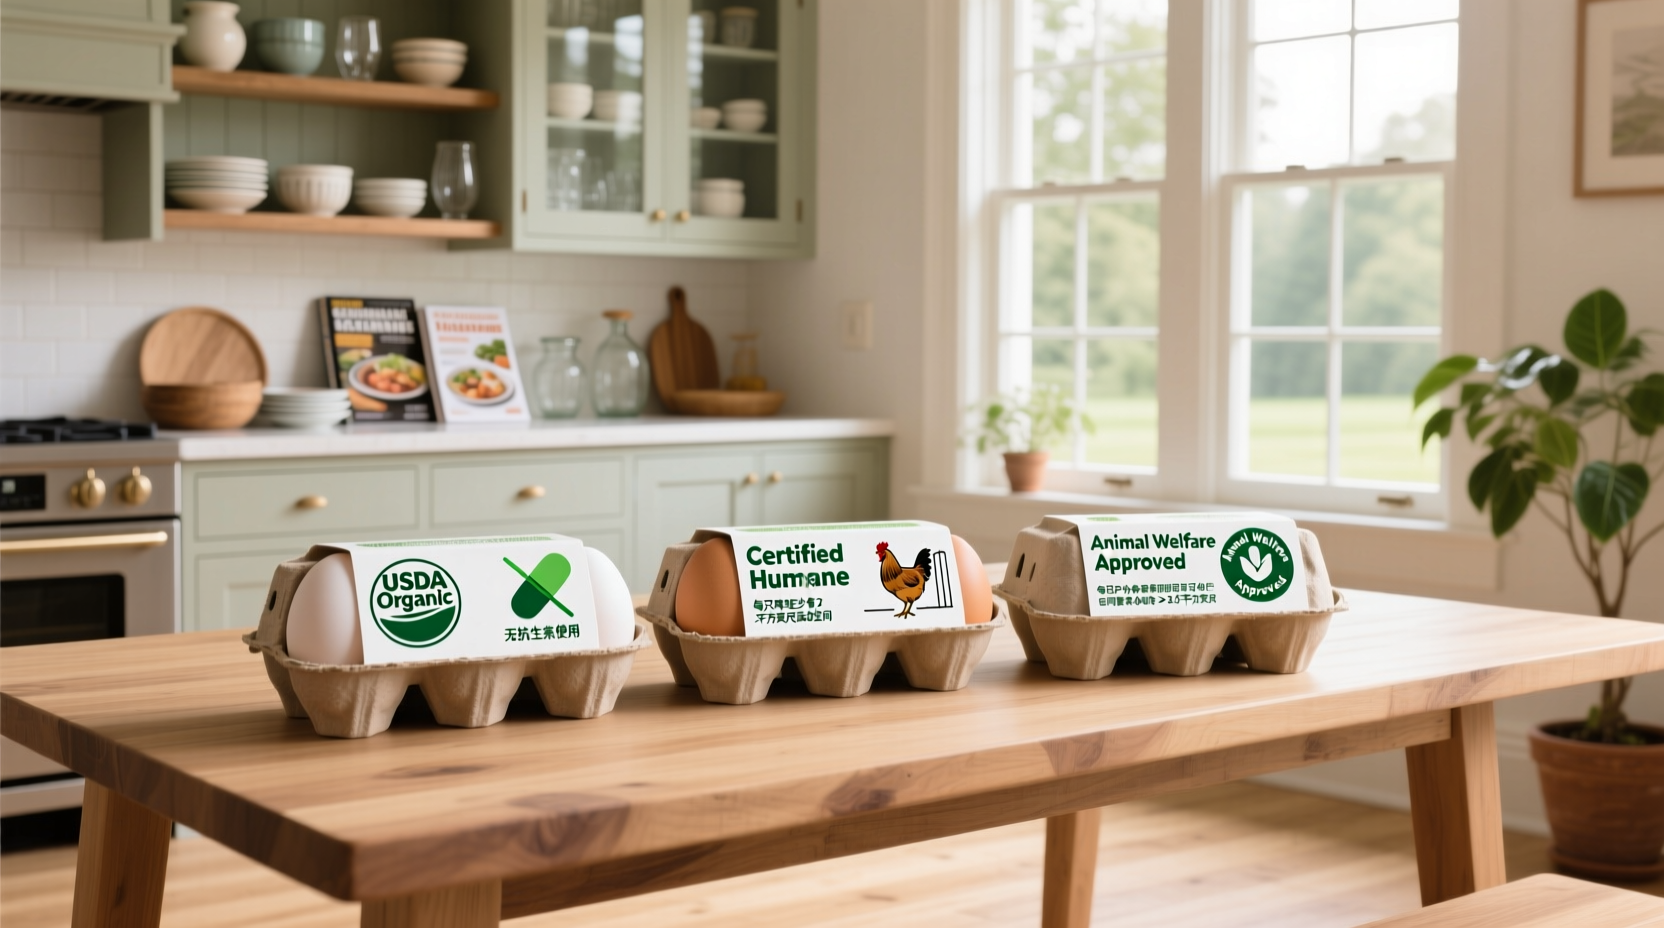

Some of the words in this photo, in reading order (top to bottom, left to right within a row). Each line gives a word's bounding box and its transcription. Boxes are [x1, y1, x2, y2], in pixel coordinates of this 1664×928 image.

[1091, 533, 1149, 551] Animal
[1151, 532, 1216, 550] Welfare
[747, 542, 843, 565] Certified
[1095, 552, 1186, 575] Approved
[382, 570, 448, 592] USDA
[750, 569, 850, 589] Humane
[377, 590, 453, 612] Organic
